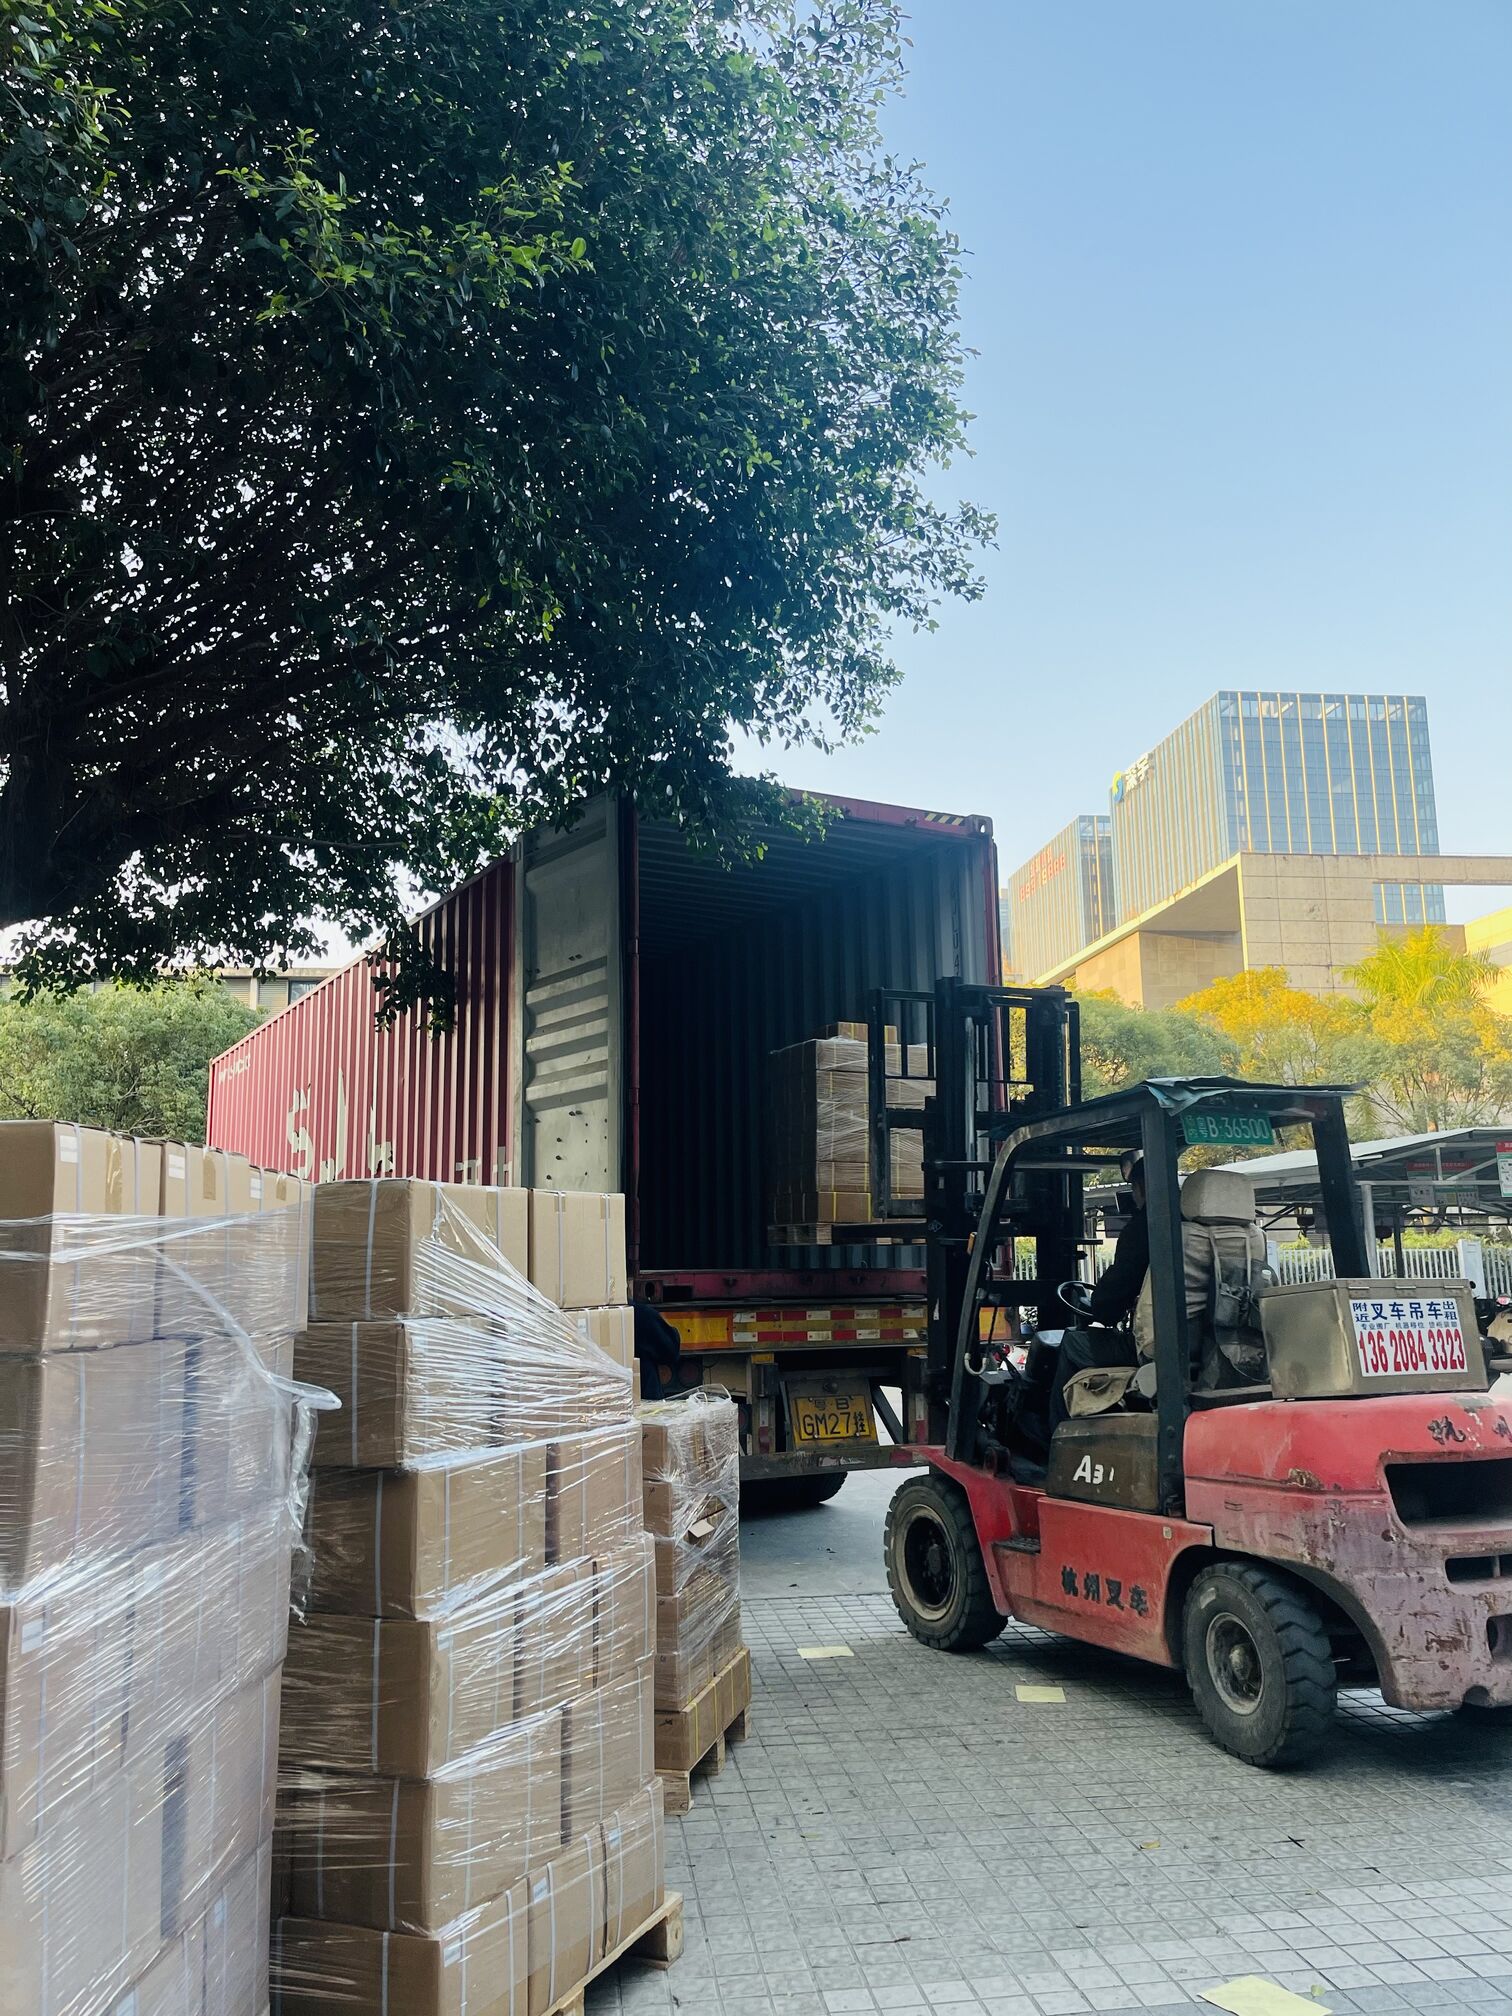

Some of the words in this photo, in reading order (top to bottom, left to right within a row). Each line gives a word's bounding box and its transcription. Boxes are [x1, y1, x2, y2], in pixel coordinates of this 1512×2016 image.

[1359, 1330, 1389, 1374] 136
[1389, 1330, 1428, 1372] 2084
[1428, 1328, 1465, 1371] 3323
[1061, 1565, 1149, 1618] 杭州叉车
